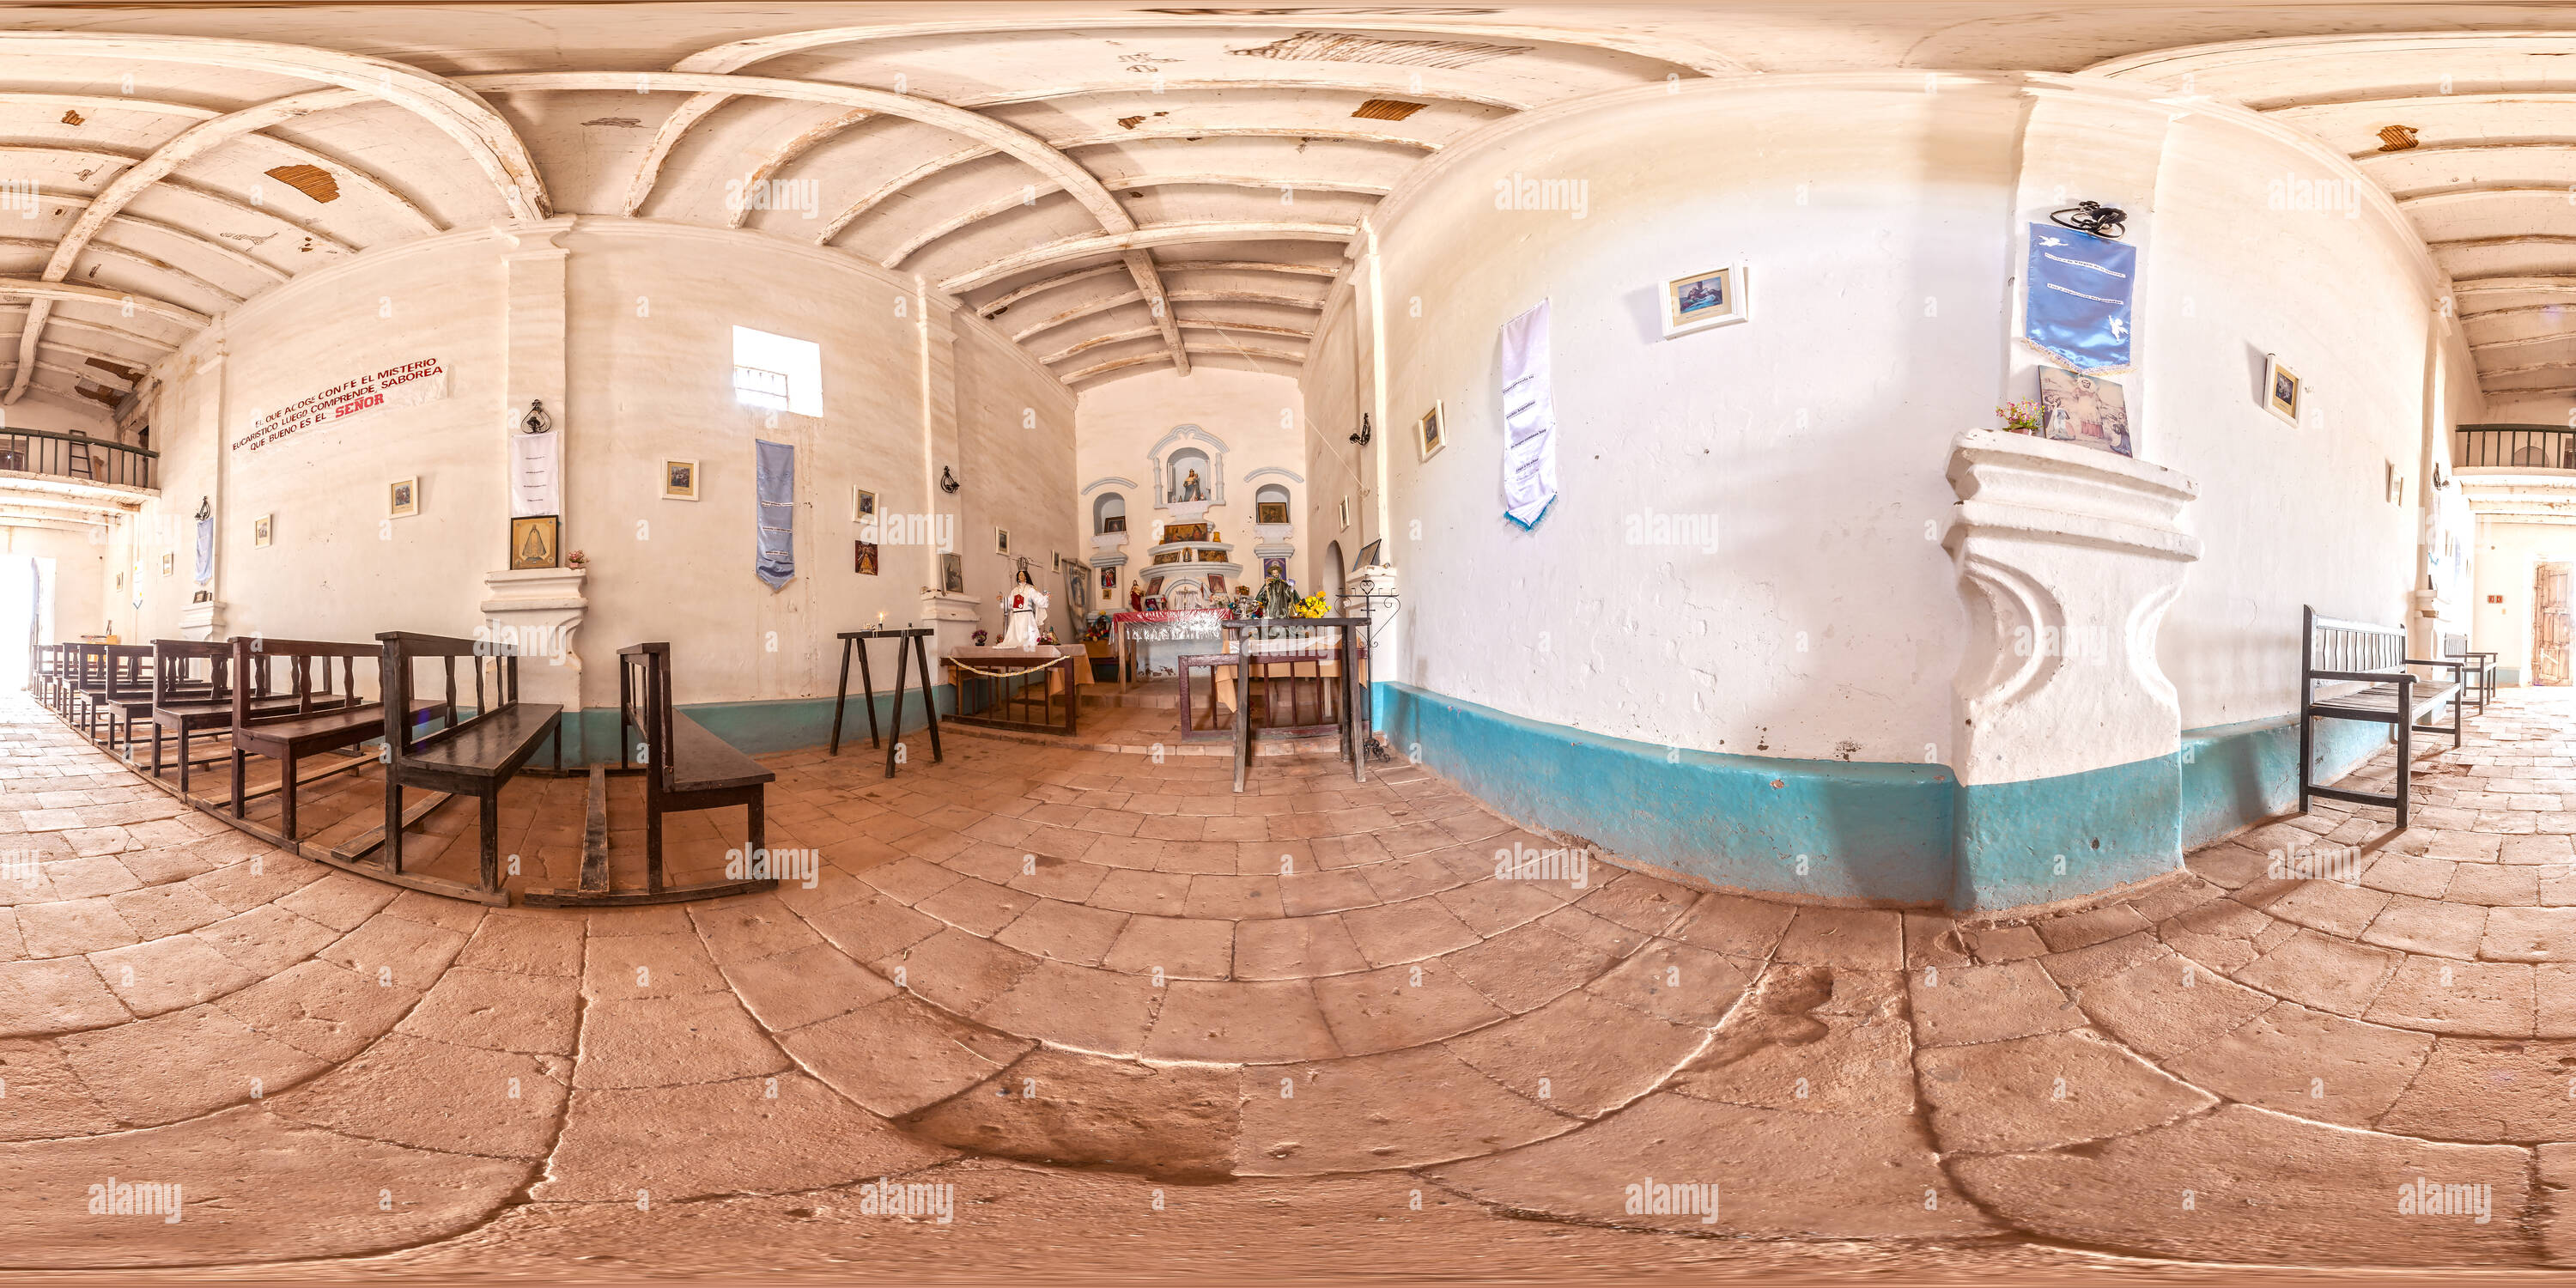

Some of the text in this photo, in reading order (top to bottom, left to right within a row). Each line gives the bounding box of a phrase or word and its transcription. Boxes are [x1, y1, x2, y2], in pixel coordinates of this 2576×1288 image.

[233, 422, 278, 451] EUCARISTICO
[282, 409, 308, 426] LUEGO
[380, 366, 443, 390] SABOREA
[250, 393, 385, 451] QUE BUENO ES EL SEÑOR
[255, 357, 437, 428] EL QUE ACOGE CON FE EL MISTERIO
